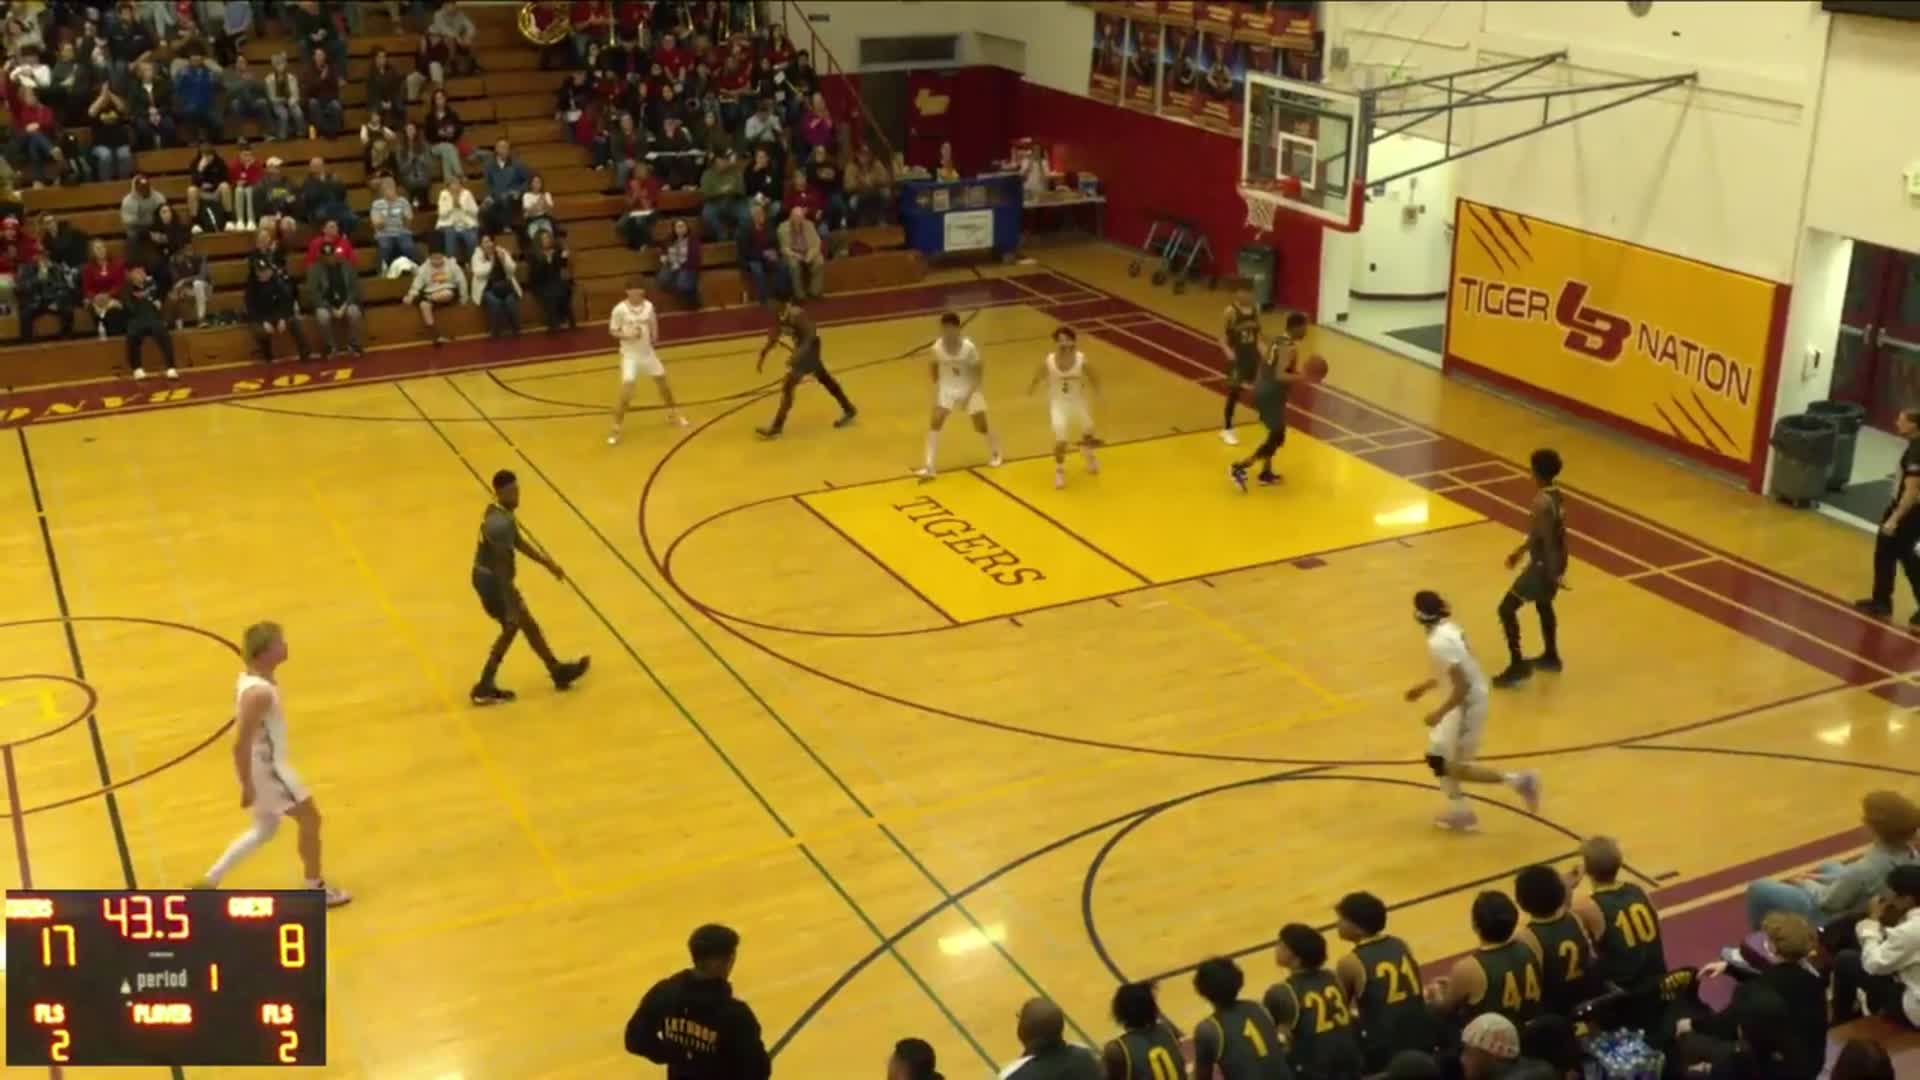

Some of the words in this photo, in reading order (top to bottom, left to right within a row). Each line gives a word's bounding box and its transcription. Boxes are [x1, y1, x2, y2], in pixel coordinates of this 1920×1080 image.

[1459, 276, 1550, 321] TIGER
[1637, 323, 1752, 405] NATION
[891, 495, 1047, 586] TIGERS
[1615, 902, 1658, 948] 10
[1375, 953, 1421, 1004] 21
[1558, 939, 1582, 981] 2
[1304, 984, 1350, 1034] 23
[1503, 962, 1542, 1011] 44
[1242, 1017, 1268, 1057] 1
